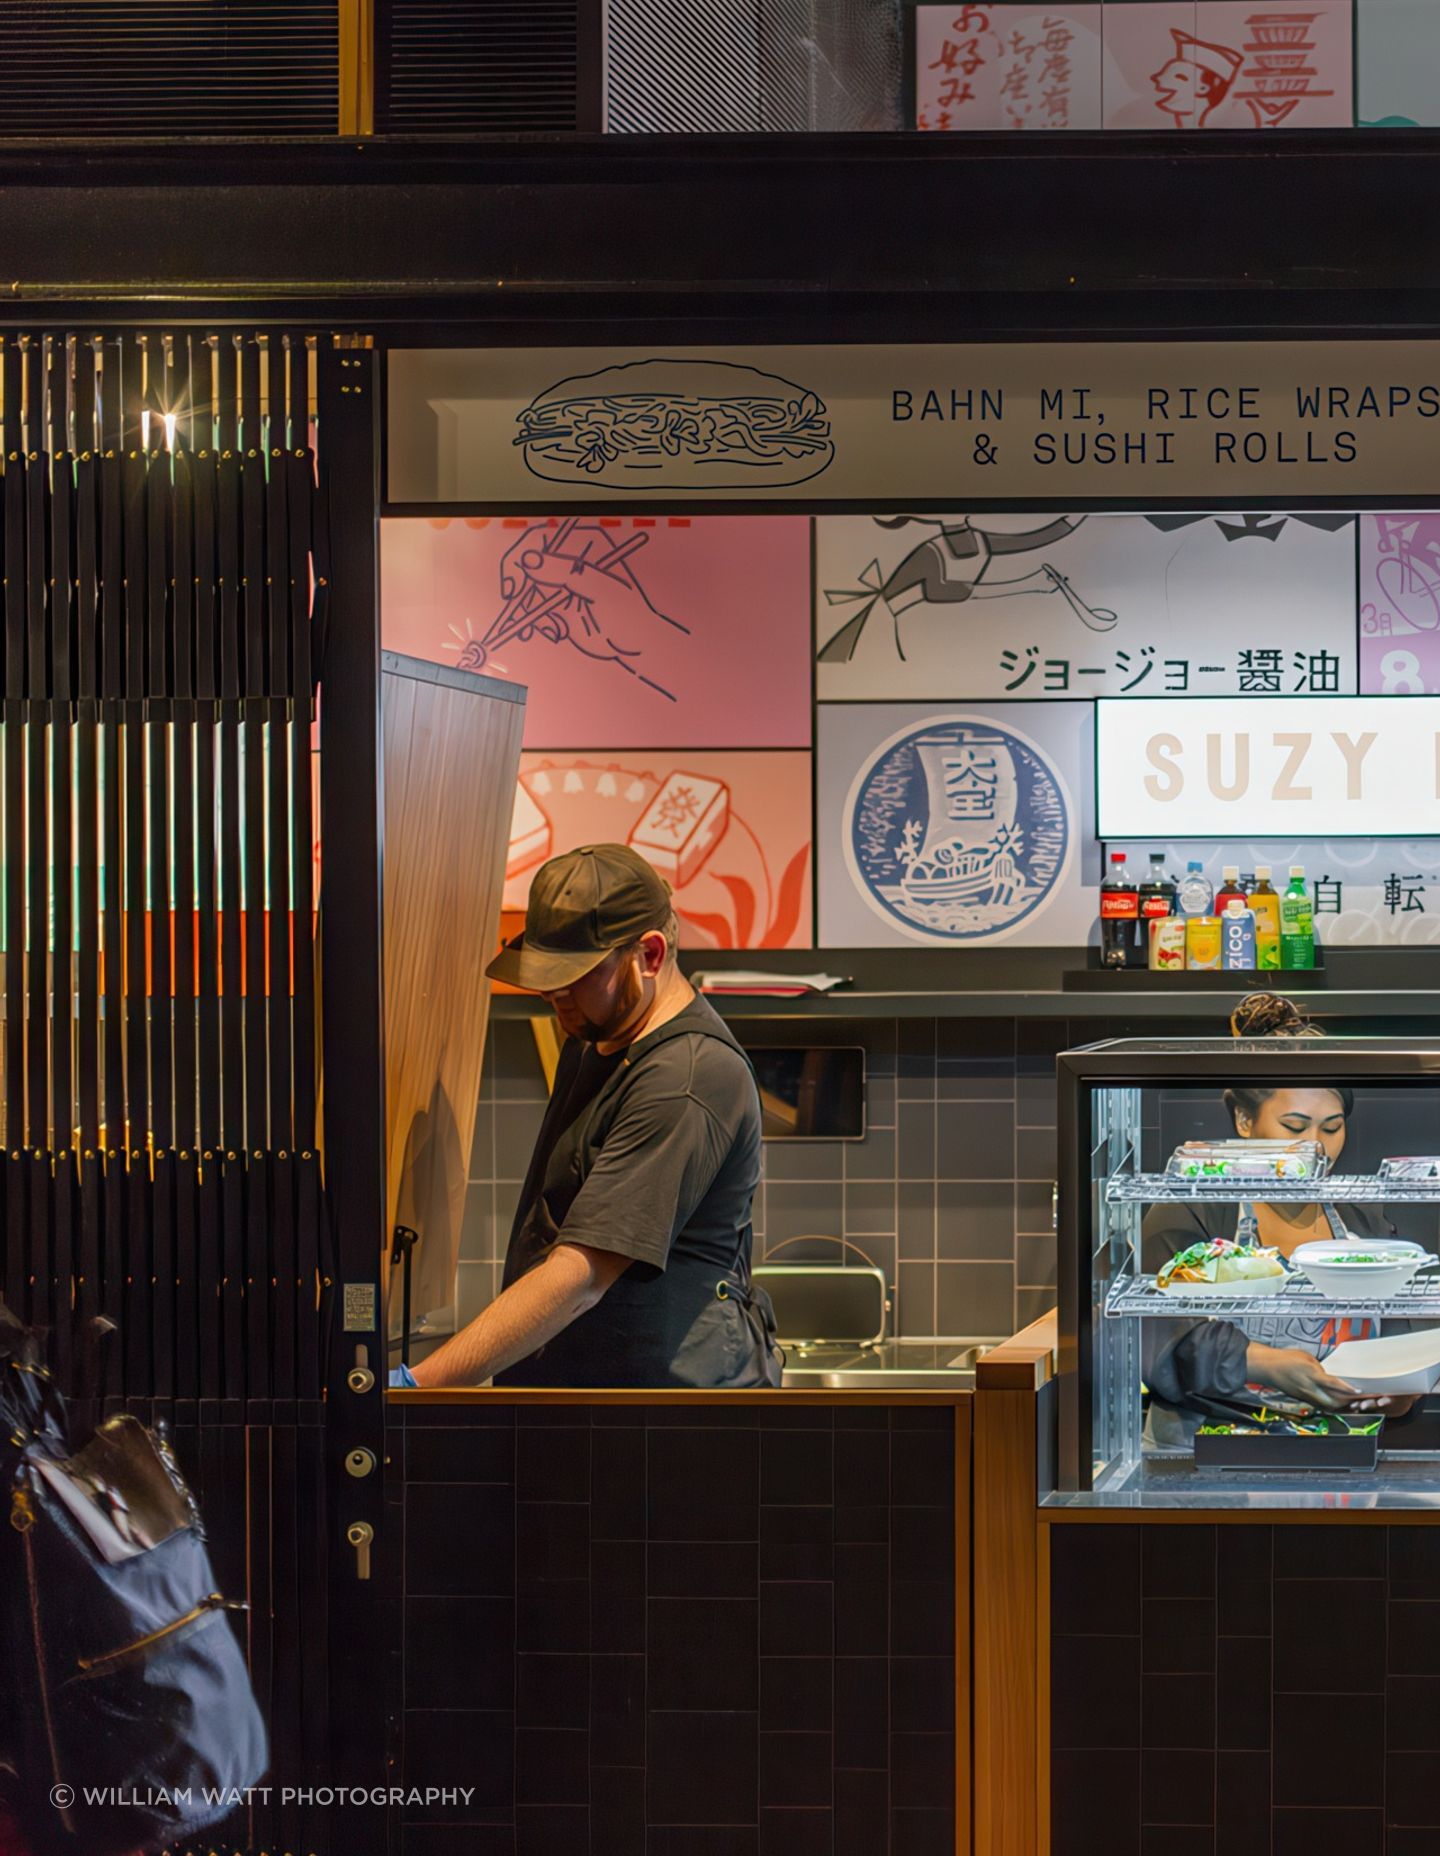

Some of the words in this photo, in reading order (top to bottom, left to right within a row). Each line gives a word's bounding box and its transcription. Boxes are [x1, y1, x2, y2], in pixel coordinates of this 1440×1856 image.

[892, 389, 1004, 422] BAHN
[1040, 388, 1106, 426] MI,
[1148, 387, 1261, 421] RICE
[1297, 386, 1440, 419] WRAPS
[971, 432, 999, 465] &
[1033, 432, 1176, 464] SUSHI
[1215, 431, 1358, 463] ROLLS
[1000, 645, 1340, 692] ジョージョー醤油
[1143, 731, 1380, 802] SUZY
